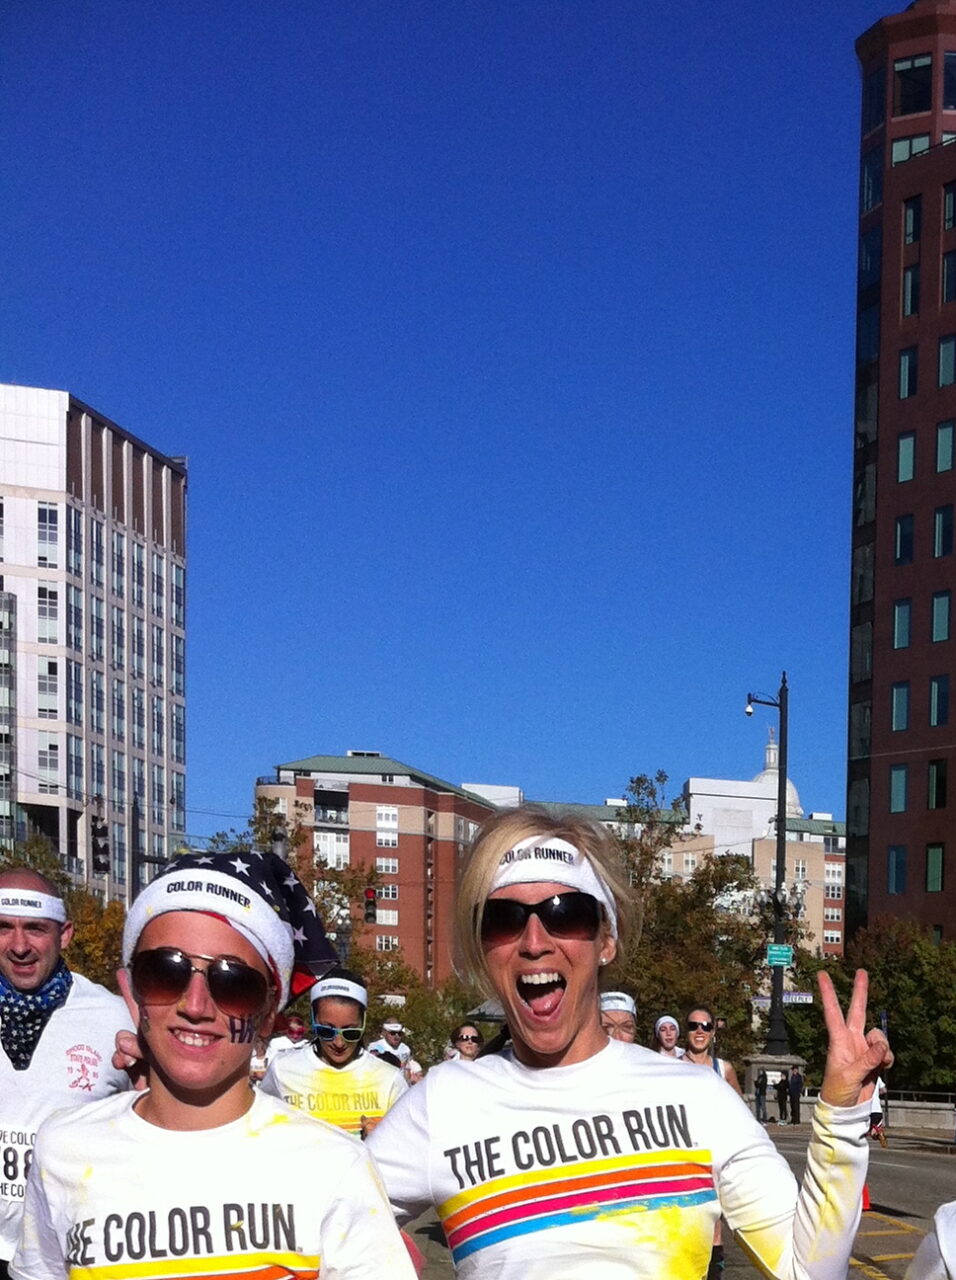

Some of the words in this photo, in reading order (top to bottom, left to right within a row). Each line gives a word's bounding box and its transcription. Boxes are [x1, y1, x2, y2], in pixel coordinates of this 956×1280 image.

[534, 847, 575, 866] RUNNER
[167, 881, 202, 893] COLOR
[206, 883, 251, 907] RUNNER
[307, 1091, 350, 1111] COLOR
[10, 1131, 37, 1146] COLO
[444, 1136, 505, 1189] THE
[511, 1114, 622, 1170] COLOR
[622, 1104, 693, 1151] RUN
[0, 1182, 8, 1196] HE
[103, 1206, 213, 1262] COLOR
[223, 1203, 297, 1252] RUN
